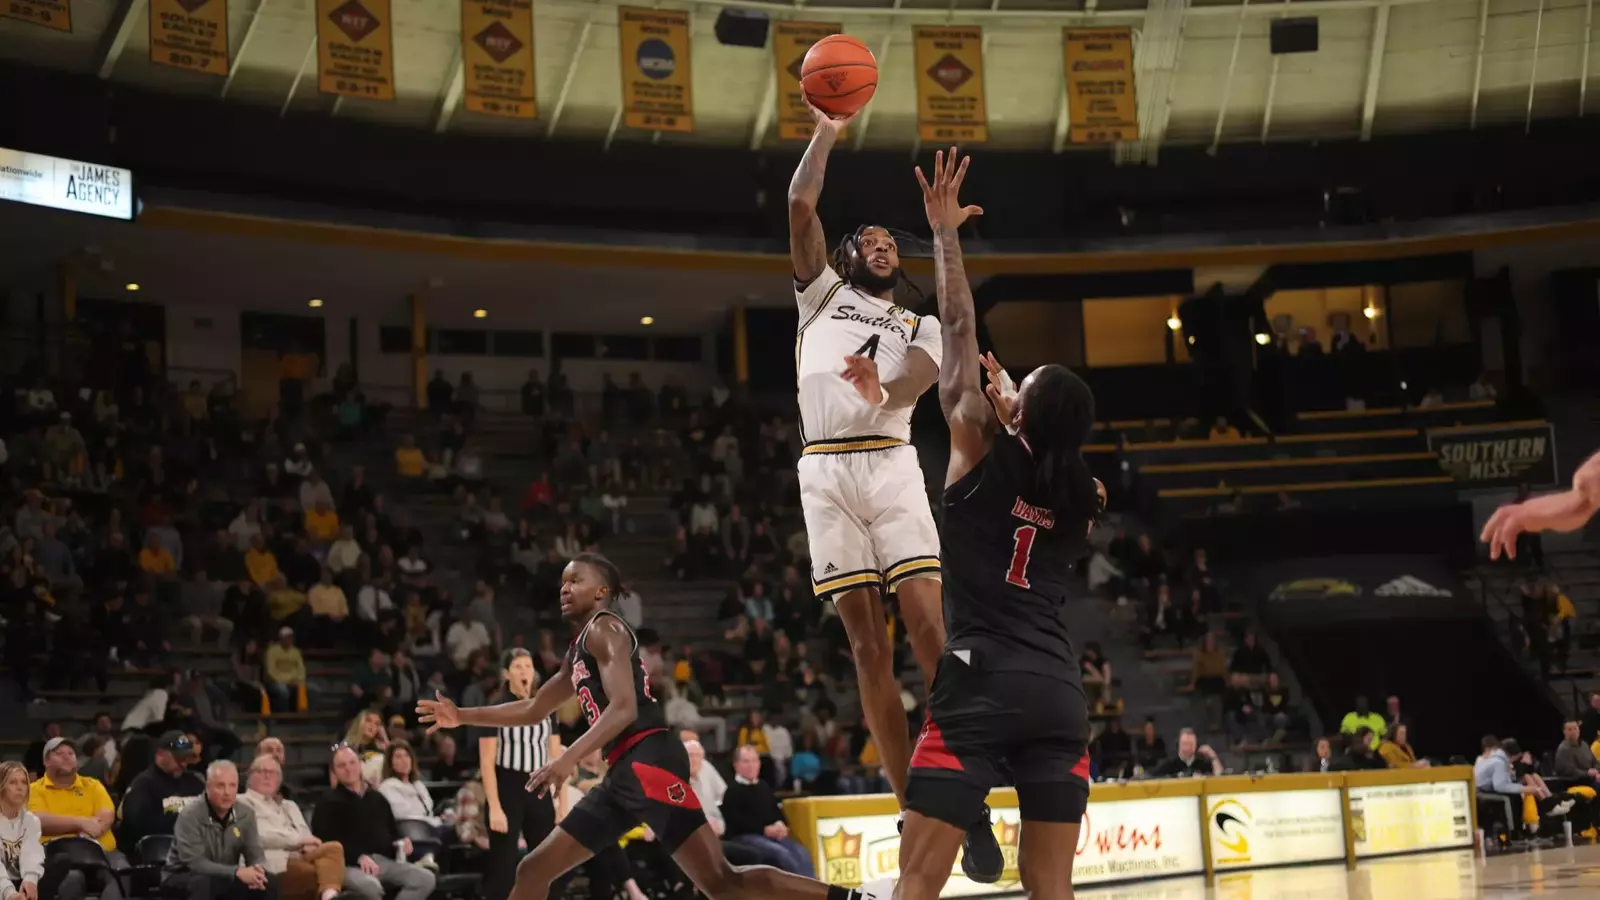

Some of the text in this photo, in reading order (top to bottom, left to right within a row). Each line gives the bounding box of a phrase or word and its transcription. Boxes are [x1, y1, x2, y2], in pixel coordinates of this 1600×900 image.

[0, 165, 43, 179] ationwide
[78, 163, 120, 187] JAMES
[66, 174, 120, 206] AGENCY
[1440, 436, 1546, 463] SOUTHERN
[1469, 460, 1512, 480] MISS
[1011, 496, 1055, 529] DAVIS
[1005, 525, 1037, 589] 1
[1073, 864, 1104, 876] siness
